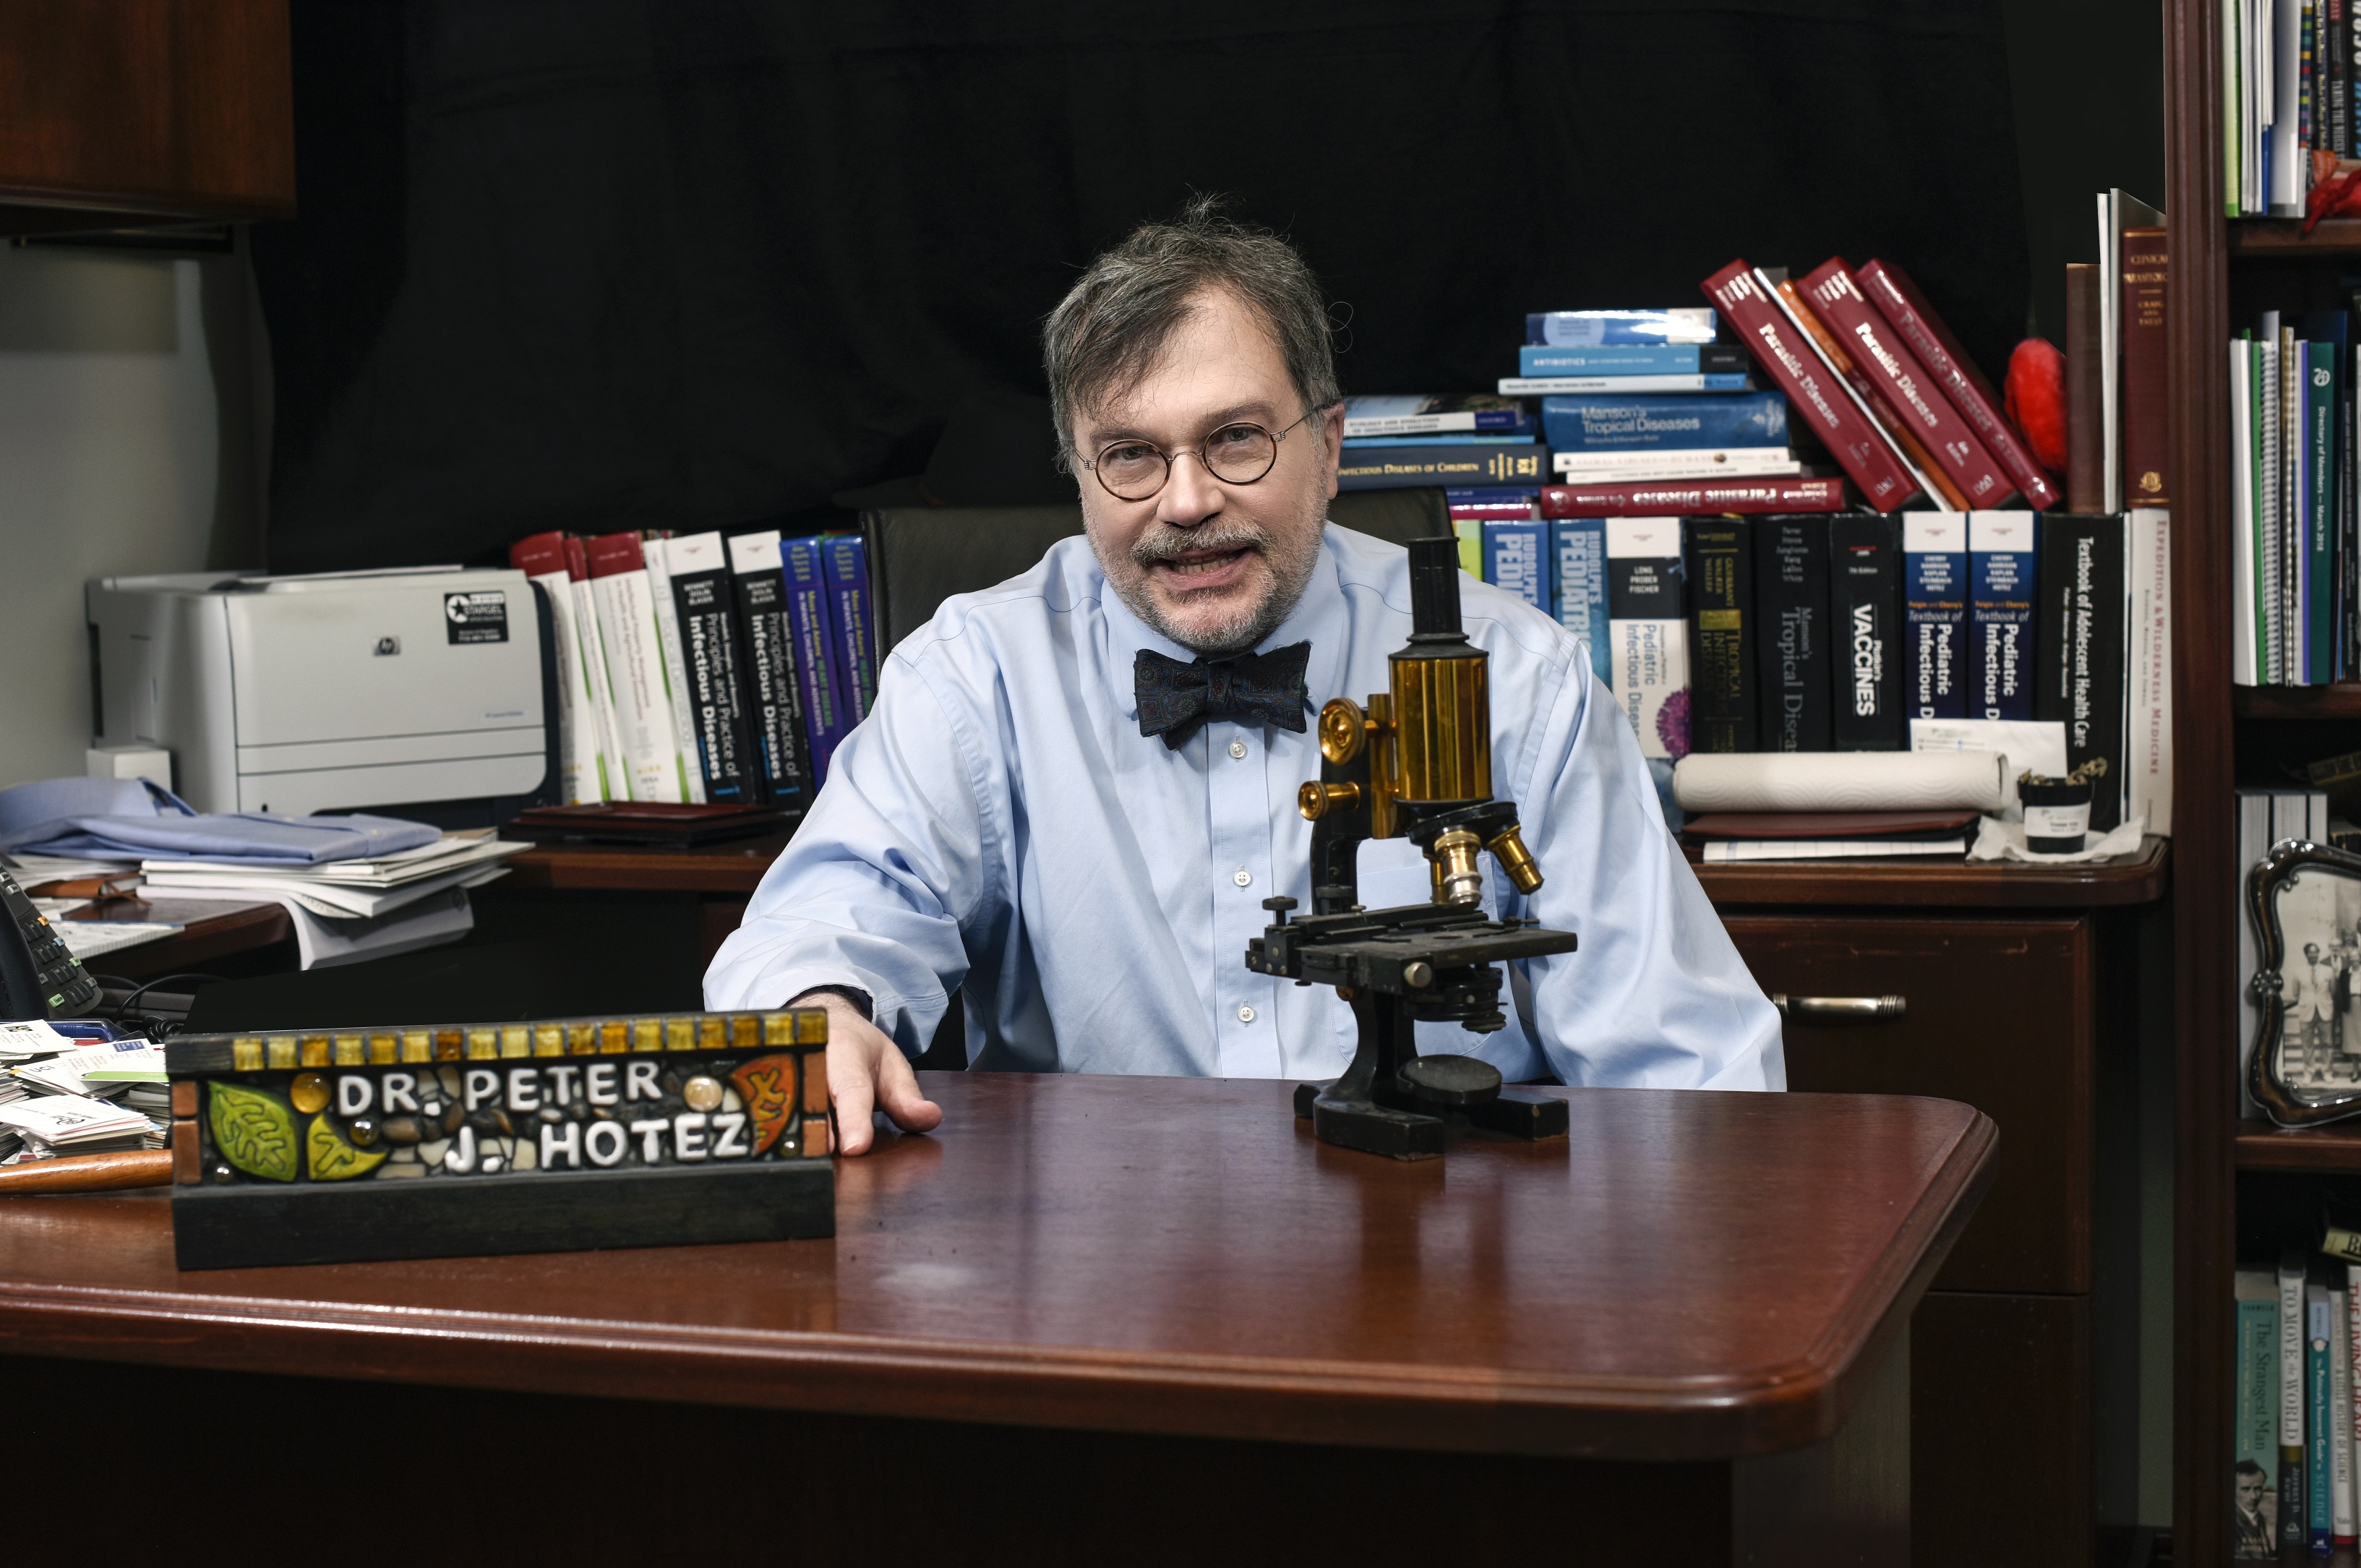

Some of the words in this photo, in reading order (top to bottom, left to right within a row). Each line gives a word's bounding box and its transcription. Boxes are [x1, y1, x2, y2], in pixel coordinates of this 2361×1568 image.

[1533, 358, 1586, 367] ANTIBIOTICS
[1758, 322, 1804, 379] Parasitic
[1799, 374, 1841, 429] Diseases
[1856, 322, 1901, 378] Parasitic
[1896, 374, 1938, 427] Diseases
[1900, 311, 1947, 372] Parasitic
[1945, 369, 1992, 432] Diseases
[1581, 405, 1647, 419] Manson's
[1582, 419, 1635, 434] Tropical
[1636, 417, 1701, 432] Diseases
[2317, 406, 2326, 444] Directory
[2317, 456, 2326, 494] Members
[2318, 445, 2326, 455] of
[1633, 490, 1700, 507] Diseases
[1705, 488, 1777, 504] Parasitic
[1634, 566, 1653, 575] LONG
[2077, 536, 2094, 593] Textbook
[2155, 520, 2167, 601] EXPEDITION
[1629, 585, 1660, 594] FISCHER
[1908, 611, 1950, 622] Textbook
[1950, 610, 1963, 622] of
[1975, 611, 2016, 622] Textbook
[2017, 610, 2030, 622] of
[2076, 594, 2094, 609] of
[706, 612, 724, 675] Principles
[768, 612, 787, 675] Principles
[1626, 624, 1641, 690] Infectious
[1644, 624, 1658, 686] Pediatric
[1777, 607, 1804, 687] Tropical
[1854, 604, 1876, 716] VACCINES
[1873, 640, 1883, 682] Plotkin's
[1919, 624, 1934, 704] Infectious
[1937, 624, 1953, 695] Pediatric
[1986, 624, 2001, 705] Infectious
[2003, 624, 2019, 697] Pediatric
[2075, 609, 2093, 676] Adolescent
[2151, 616, 2166, 703] WILDERNESS
[689, 616, 711, 703] Infectious
[702, 706, 721, 781] Diseases
[714, 678, 730, 705] and
[751, 615, 773, 703] Infectious
[763, 706, 783, 780] Diseases
[775, 677, 792, 705] and
[2073, 678, 2091, 720] Health
[719, 707, 736, 761] Practice
[779, 707, 797, 761] Practice
[1783, 694, 1804, 753] Disea
[2074, 721, 2091, 748] Care
[2150, 707, 2162, 775] MEDICINE
[725, 761, 740, 778] of
[785, 761, 800, 779] of
[338, 1074, 441, 1116] DR.
[464, 1061, 662, 1113] PETER
[445, 1126, 504, 1173] J.
[541, 1113, 749, 1170] HOTEZ
[2284, 1285, 2298, 1308] TO
[2256, 1321, 2272, 1349] The
[2284, 1312, 2299, 1360] MOVE
[2252, 1352, 2272, 1415] Strangest
[2285, 1378, 2300, 1440] WORLD
[2315, 1369, 2326, 1404] Politically
[2254, 1419, 2271, 1451] Man
